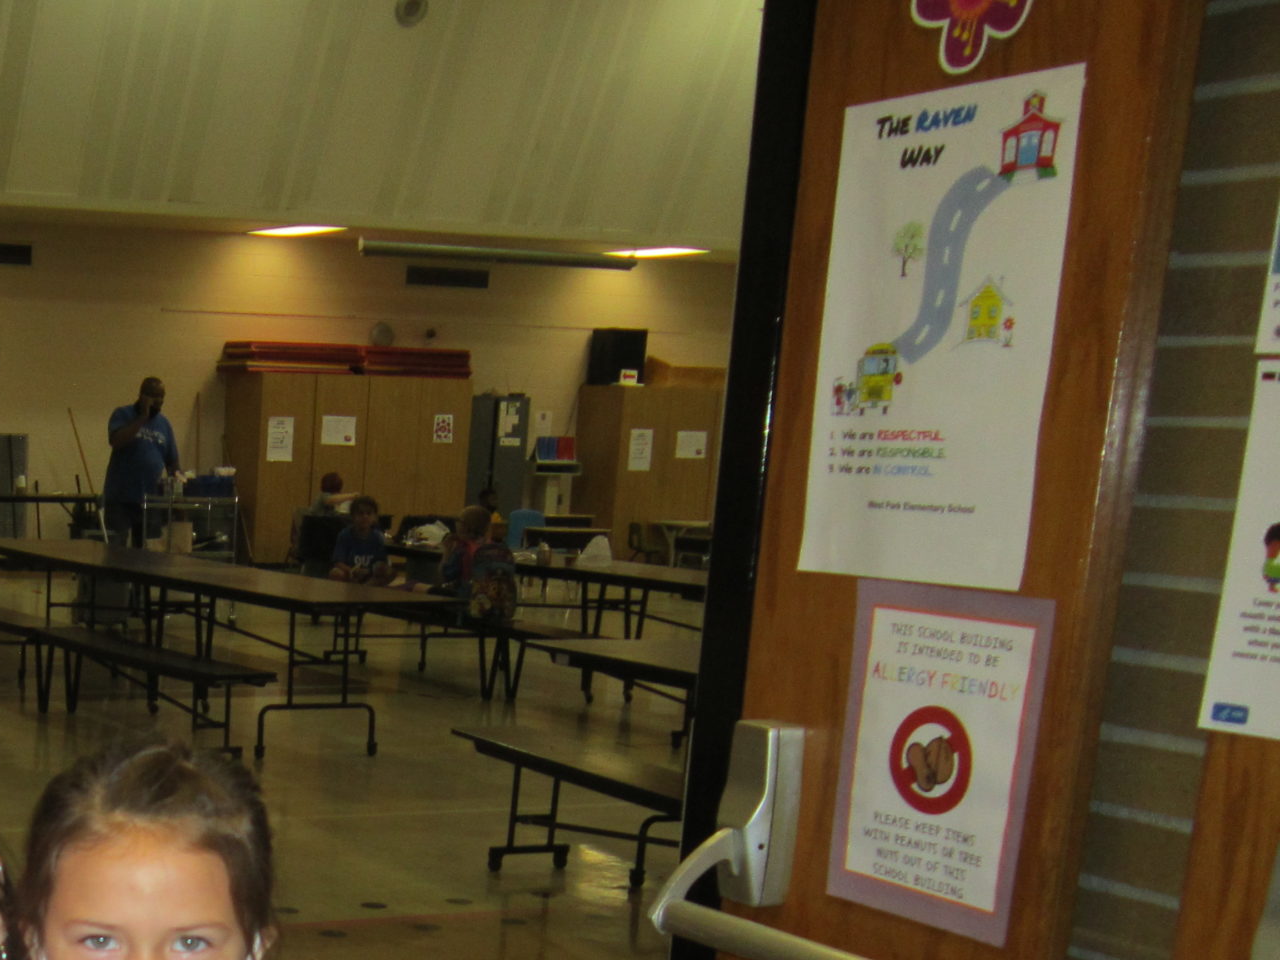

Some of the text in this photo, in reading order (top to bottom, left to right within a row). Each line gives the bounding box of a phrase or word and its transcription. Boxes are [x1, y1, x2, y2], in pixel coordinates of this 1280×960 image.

[877, 104, 978, 140] THE RAVEN
[900, 144, 945, 169] WAY
[891, 622, 1013, 652] THIS SCHOOL BUILDING
[897, 641, 1000, 668] IS INTENDED TO BE
[872, 661, 1019, 701] ALLERGY FRIENDLY
[873, 811, 976, 846] PLEASE KEEP ITEMS
[863, 827, 982, 868] WITH PEANUTS OR TREE
[876, 848, 967, 881] NUTS OUT OF THIS
[872, 862, 963, 900] SCHOOL BUILDING
